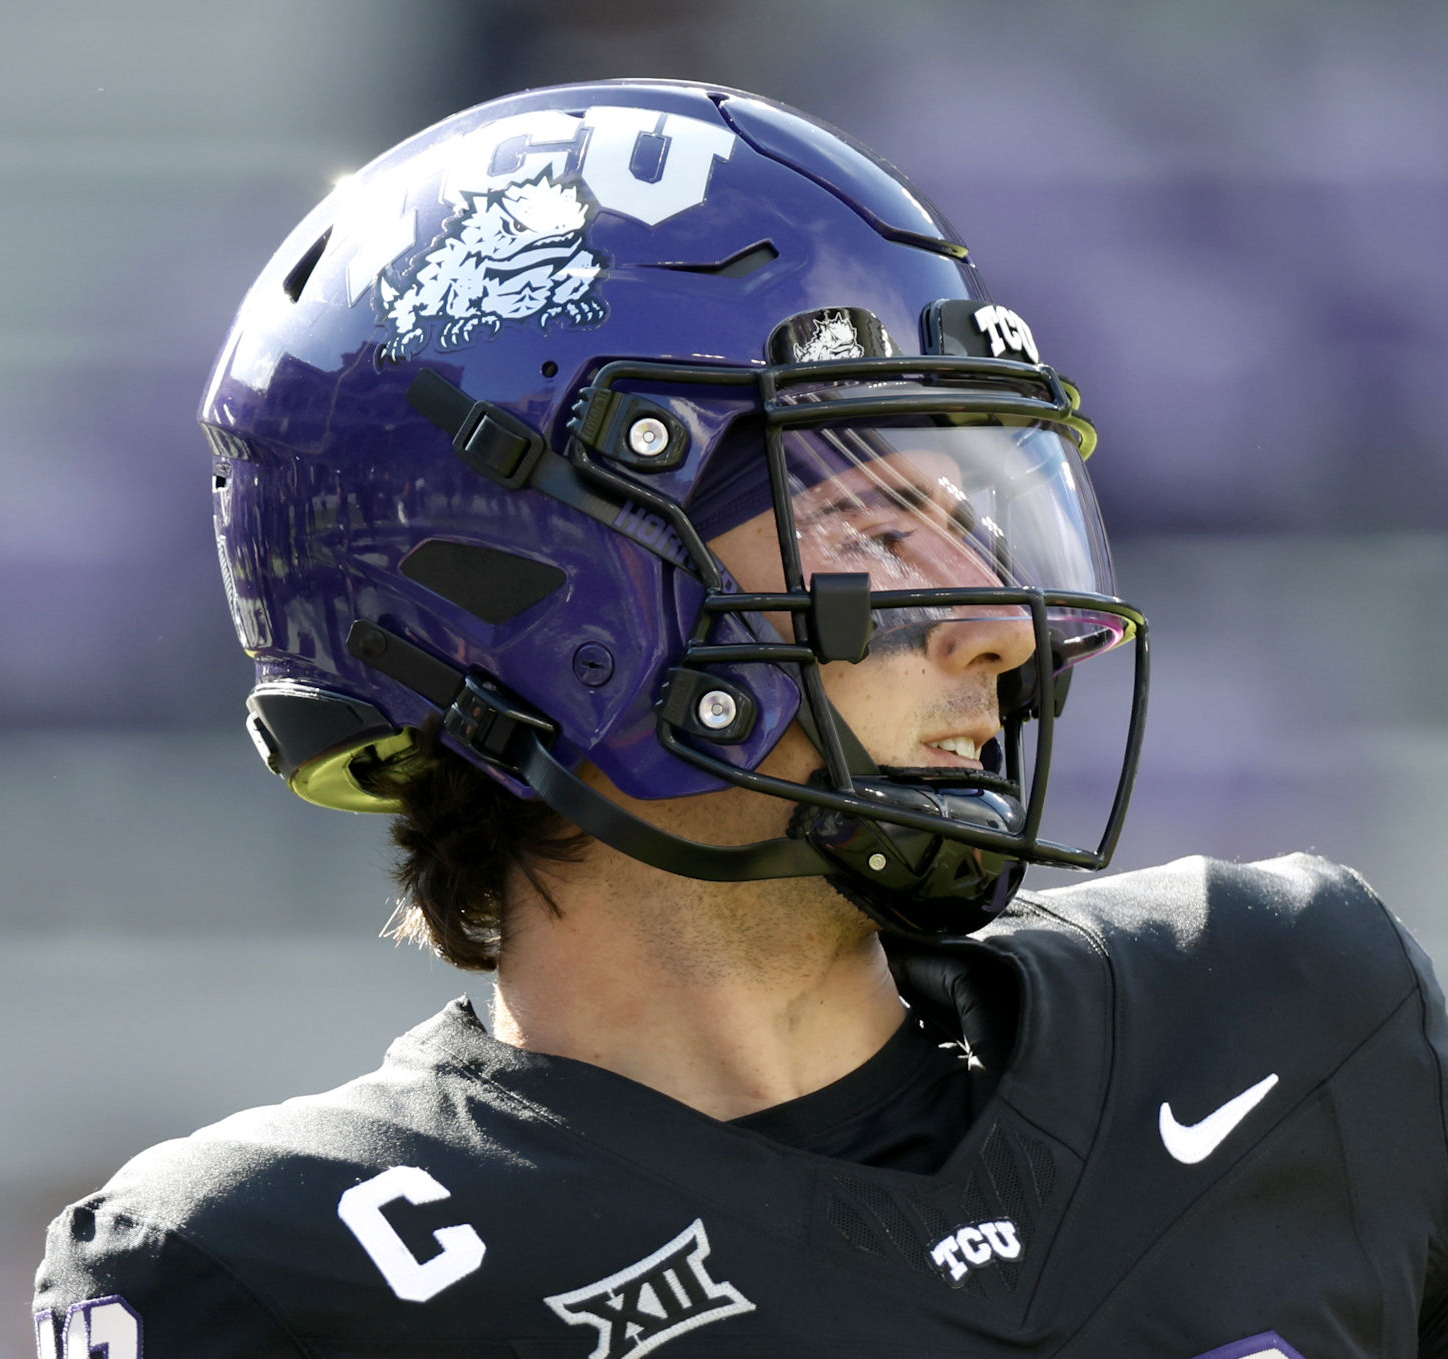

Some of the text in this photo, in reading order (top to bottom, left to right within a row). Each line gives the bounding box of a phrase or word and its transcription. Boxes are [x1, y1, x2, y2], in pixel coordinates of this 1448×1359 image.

[973, 304, 1040, 364] TCU
[337, 1165, 487, 1303] C
[929, 1220, 1022, 1282] TCU
